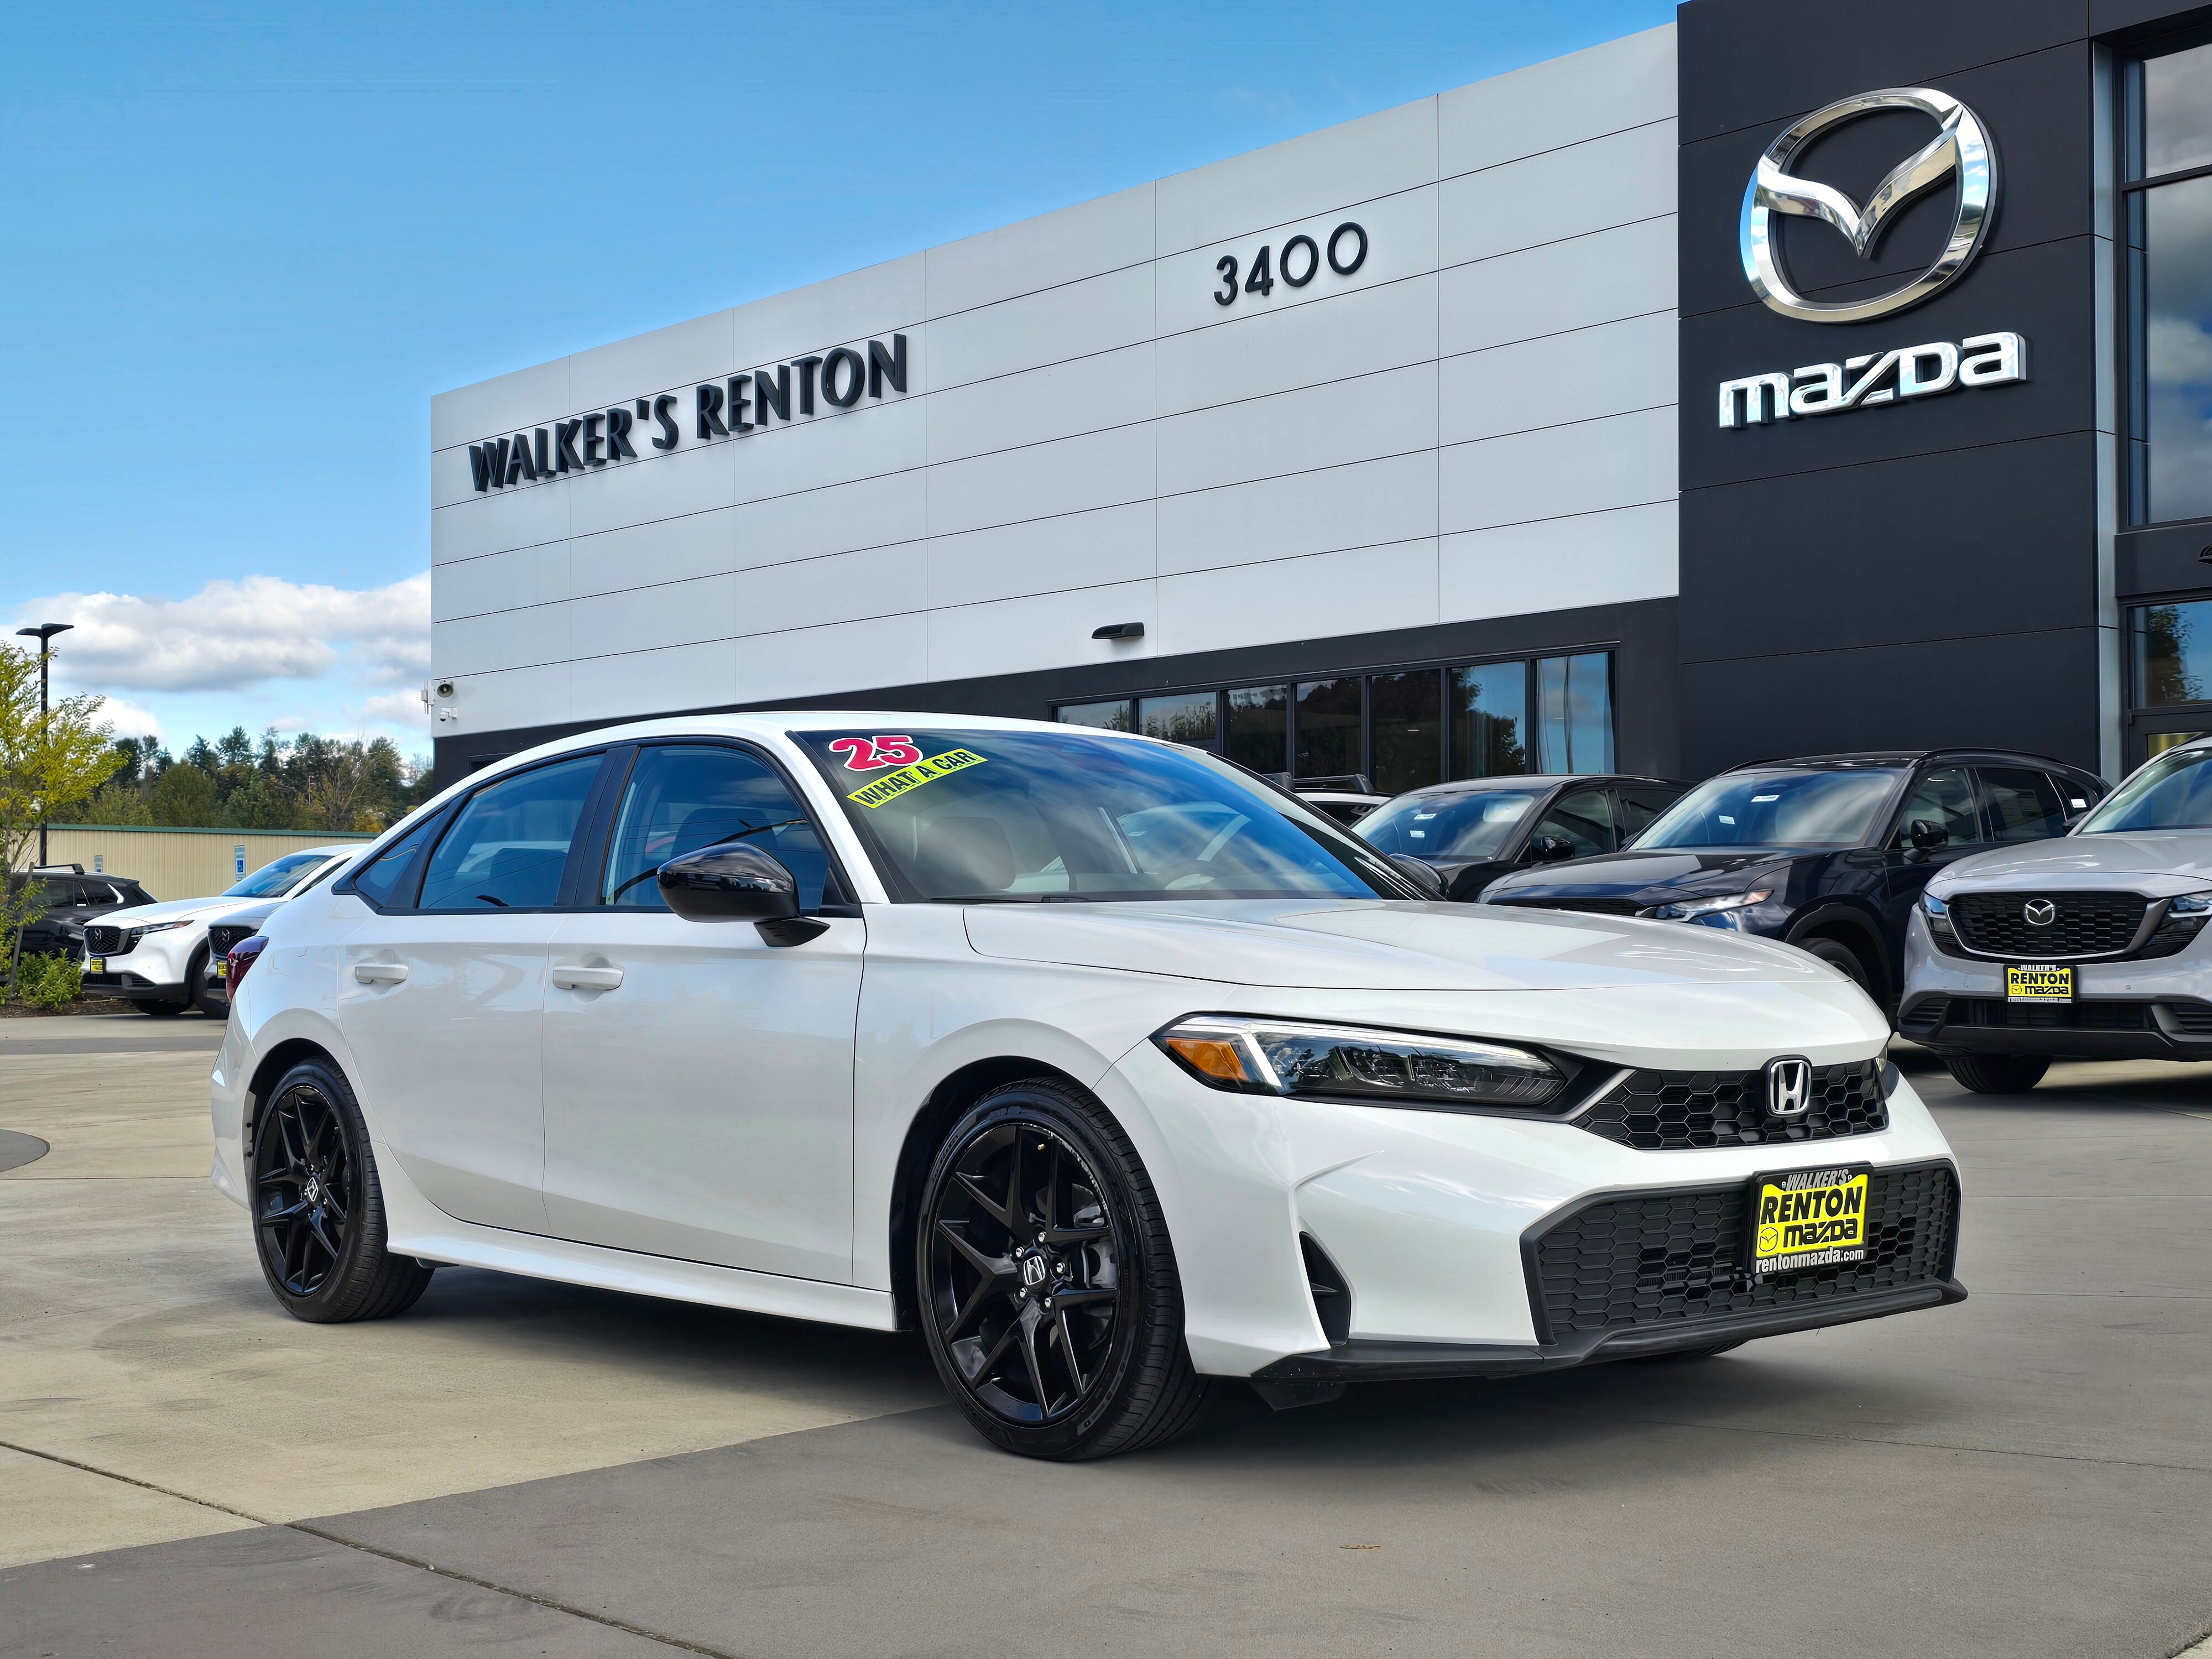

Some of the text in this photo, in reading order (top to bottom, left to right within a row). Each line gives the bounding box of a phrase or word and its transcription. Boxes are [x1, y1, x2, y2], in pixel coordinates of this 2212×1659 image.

[1214, 221, 1368, 306] 3400
[1719, 331, 2026, 428] mazda
[468, 333, 907, 492] WALKER'S RENTON
[828, 735, 924, 772] 25
[856, 750, 978, 805] WHAT A CAR
[2010, 973, 2069, 984] RENTON
[1785, 1168, 1849, 1192] WALKER'S
[1760, 1186, 1863, 1225] RENTON
[1756, 1246, 1864, 1274] rentonmazda.com
